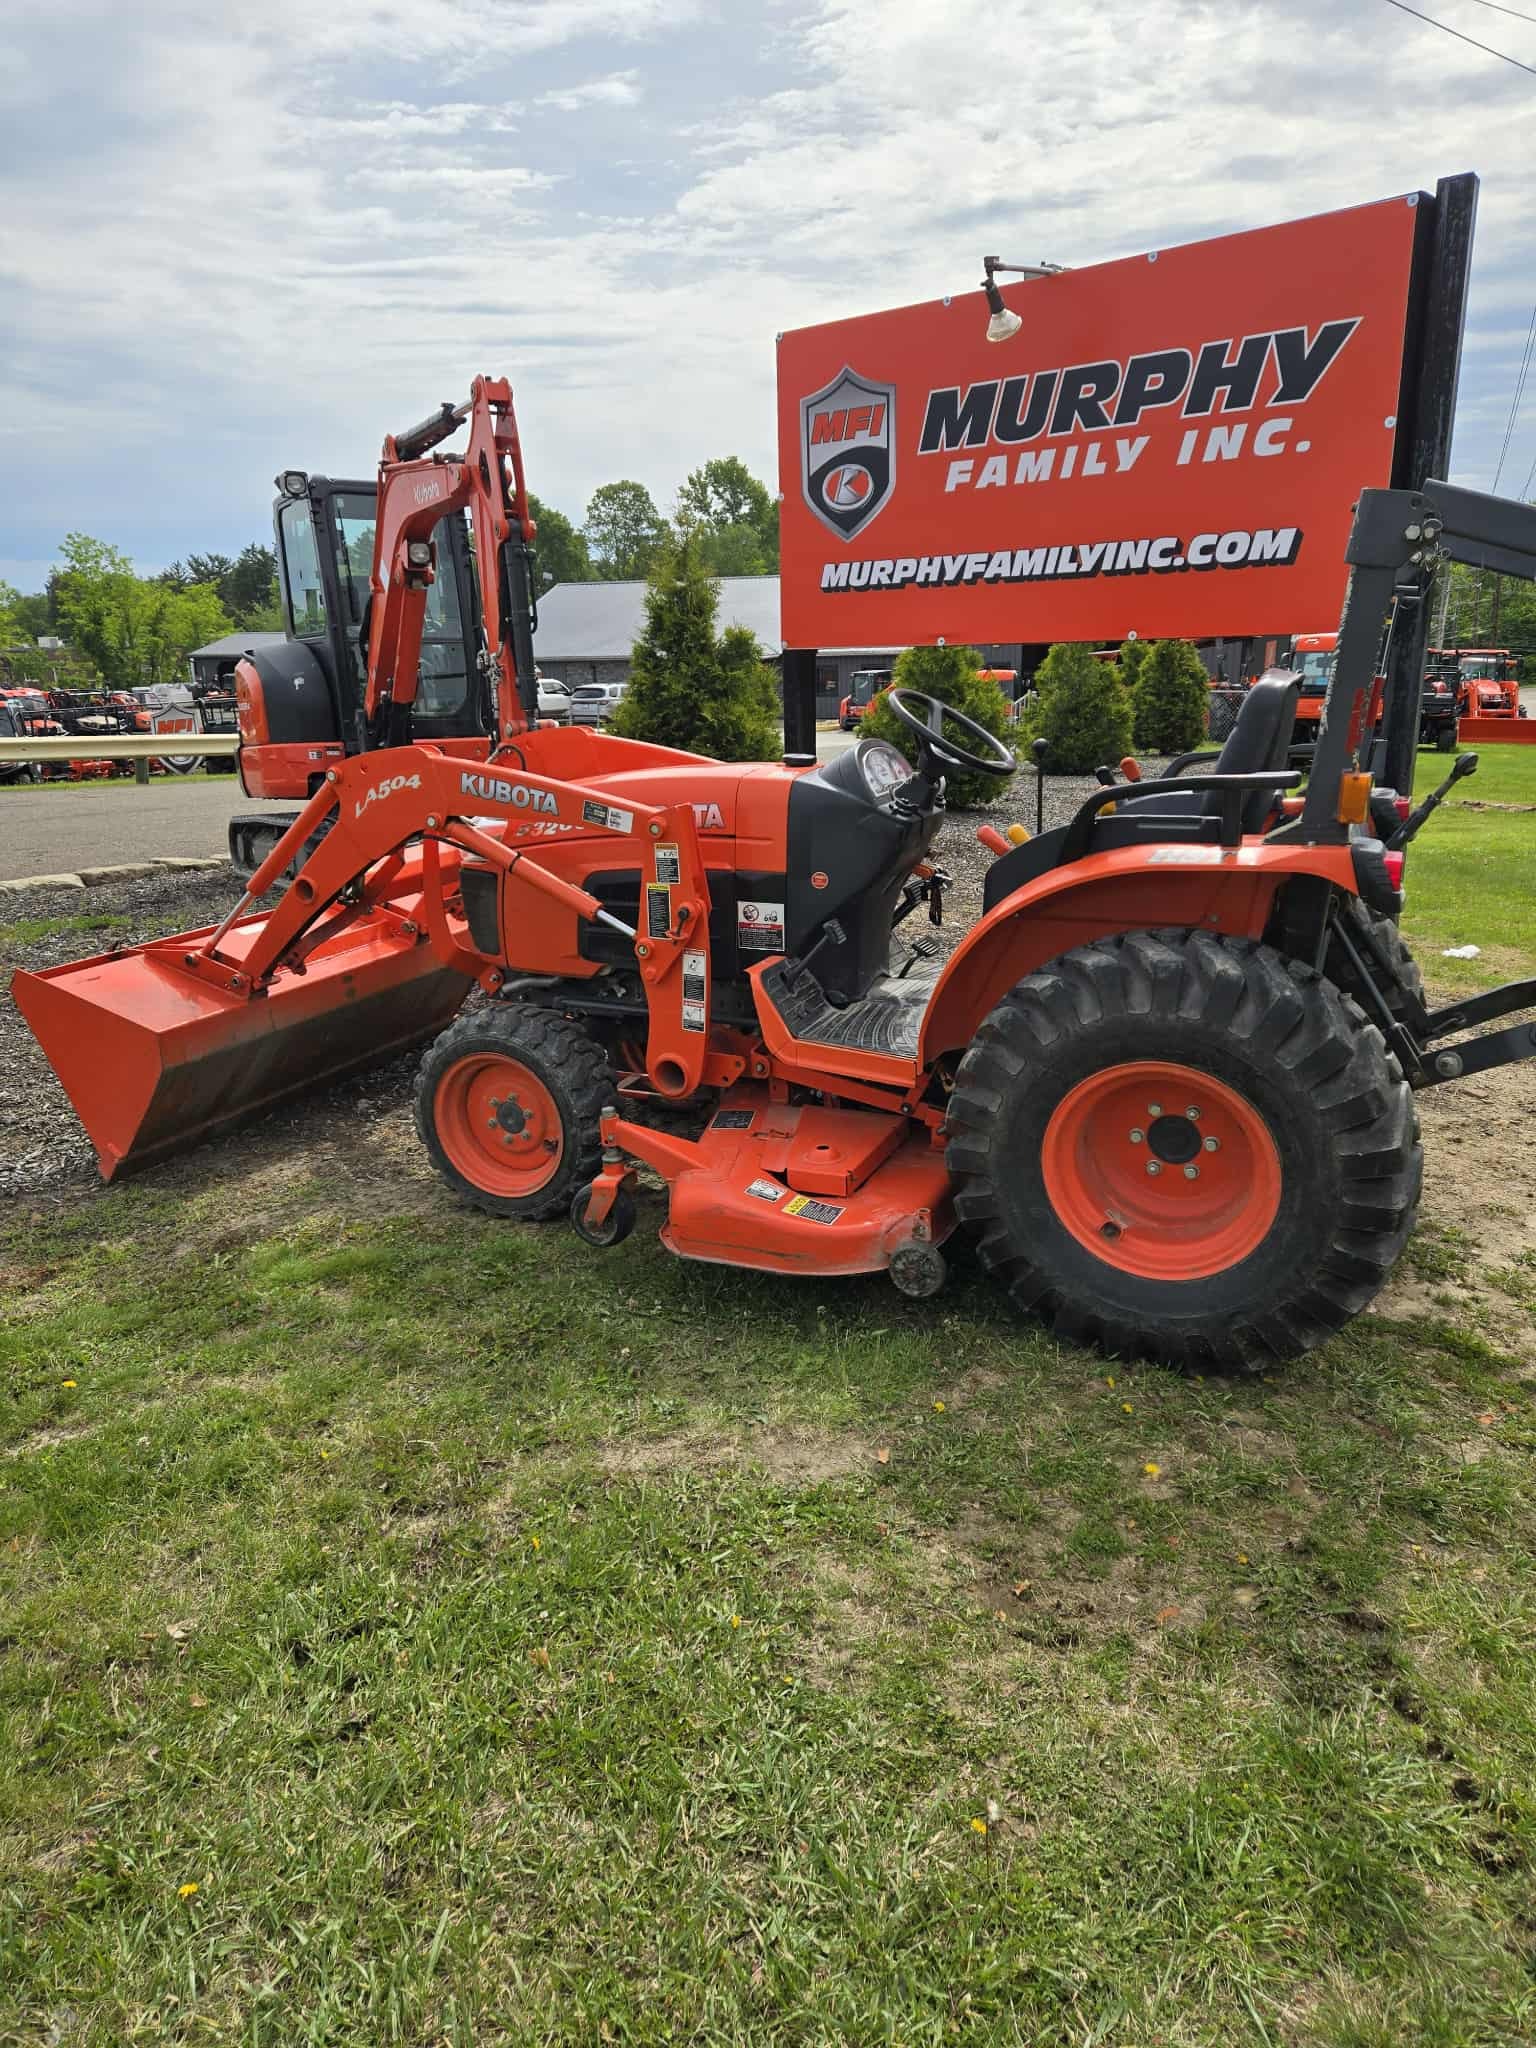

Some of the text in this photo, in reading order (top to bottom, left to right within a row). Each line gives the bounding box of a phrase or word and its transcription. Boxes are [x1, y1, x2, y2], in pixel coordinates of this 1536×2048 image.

[916, 316, 1364, 455] MURPHY
[810, 402, 886, 446] MFI
[945, 417, 1311, 493] FAMILY INC.
[820, 527, 1302, 592] MURPHYFAMILYINC.COM
[355, 774, 422, 819] LA504
[460, 772, 560, 816] KUBOTA
